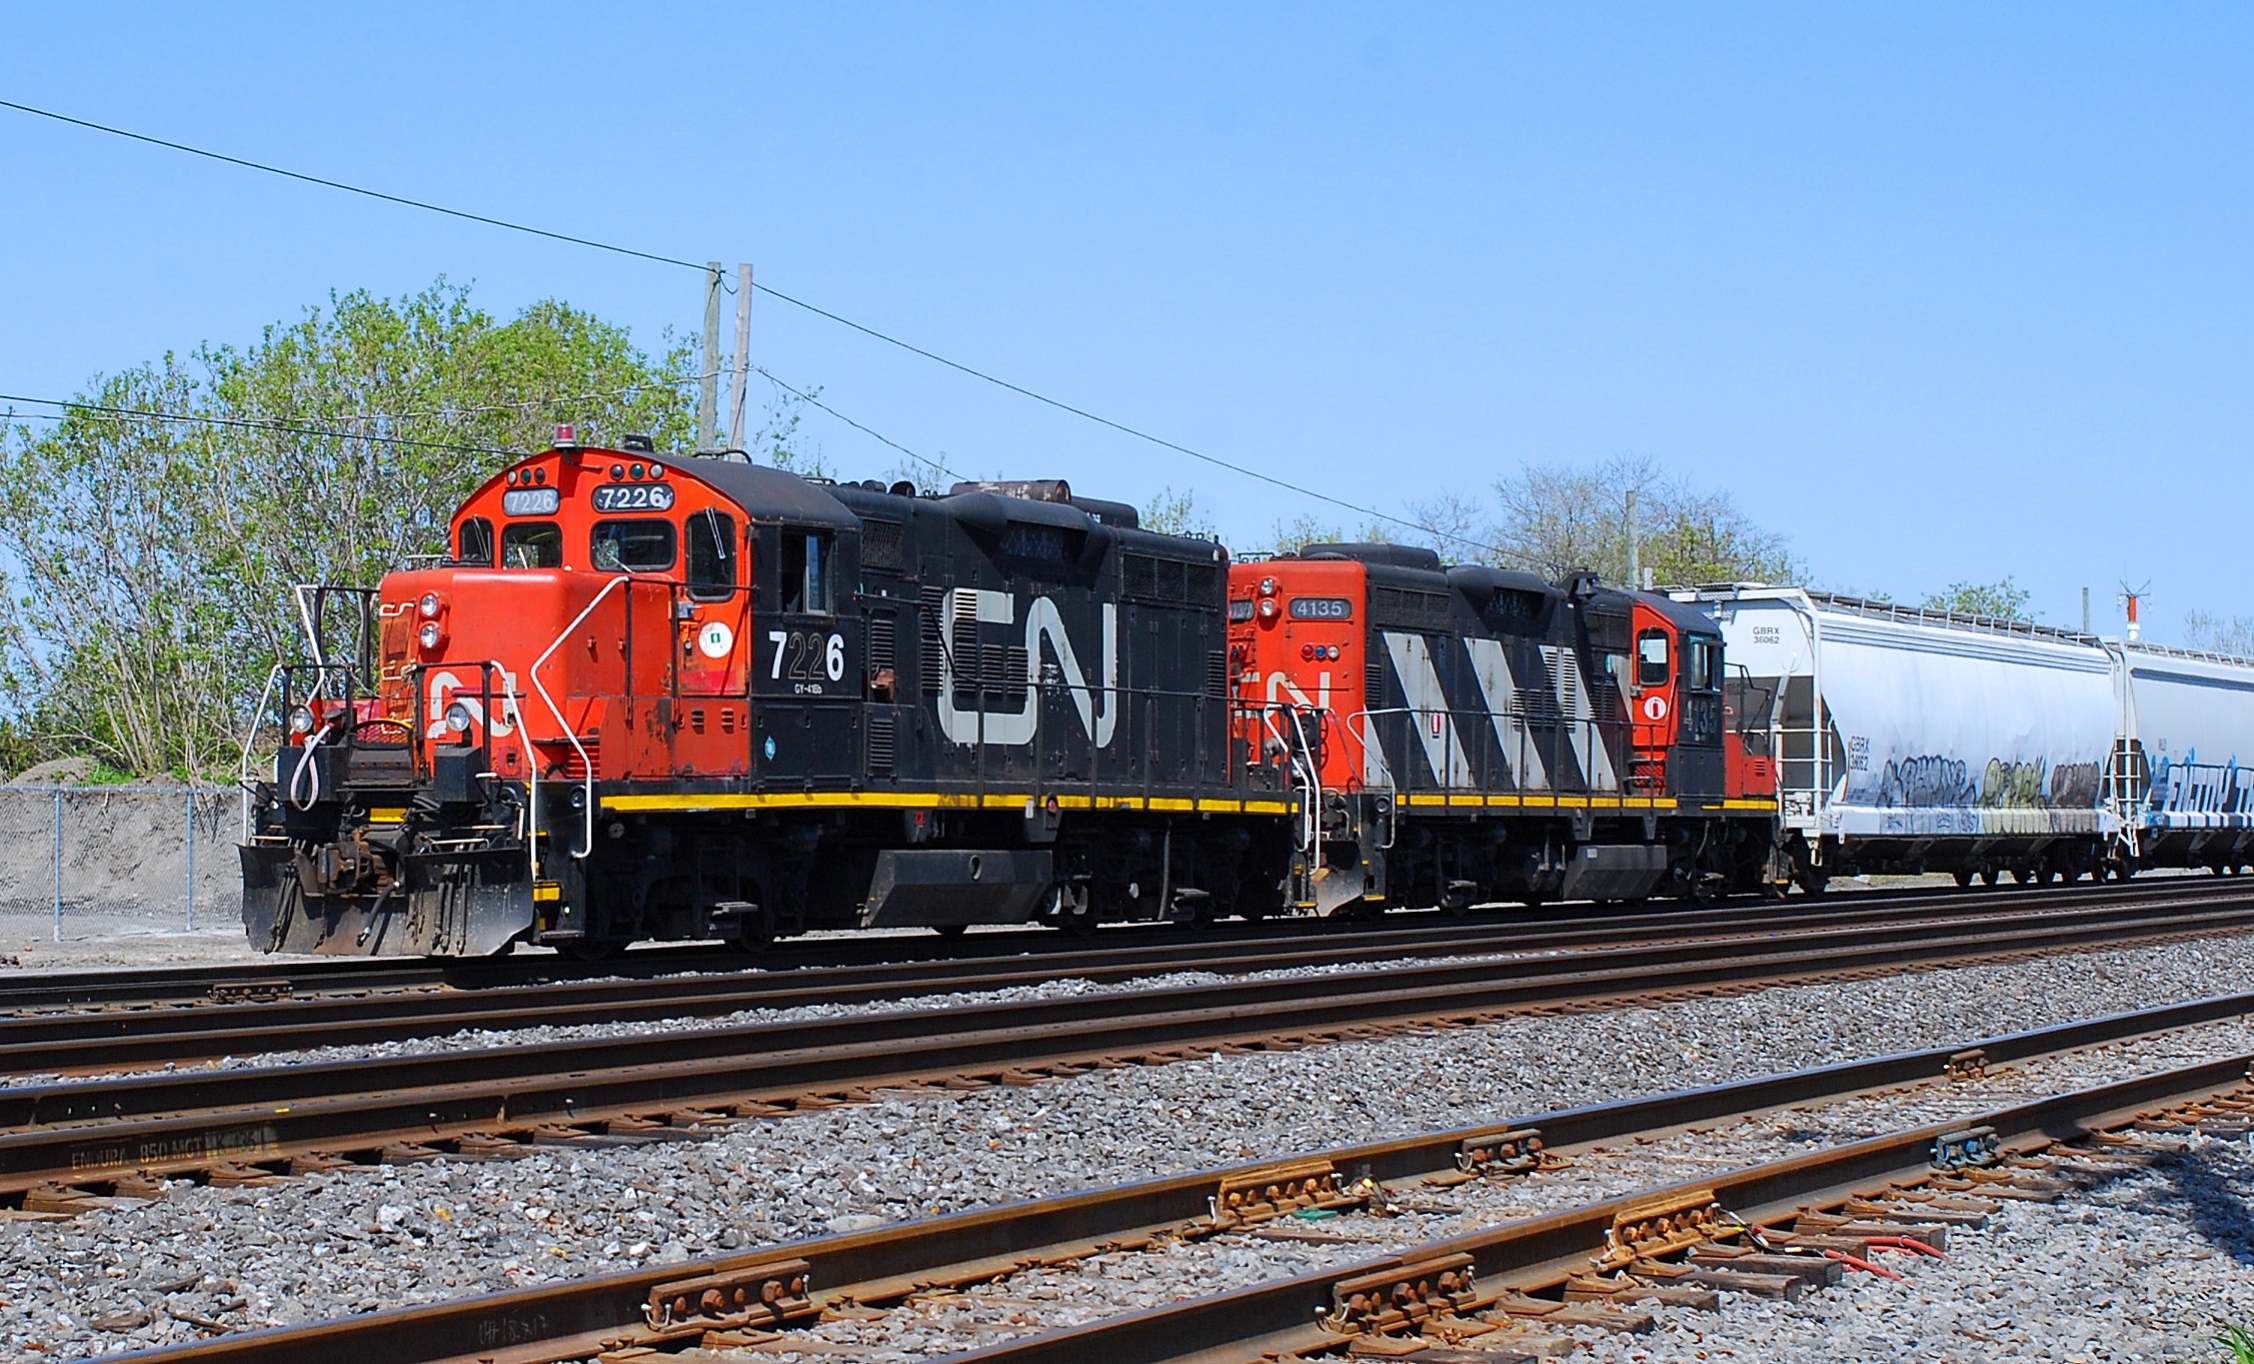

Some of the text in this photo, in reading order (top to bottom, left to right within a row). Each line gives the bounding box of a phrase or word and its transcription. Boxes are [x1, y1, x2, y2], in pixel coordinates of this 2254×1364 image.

[509, 491, 553, 513] 7226
[601, 486, 665, 510] 7226
[1296, 600, 1343, 617] 4135
[1752, 626, 1780, 635] GBRX
[1753, 635, 1780, 645] 36062
[768, 630, 845, 682] 7226
[939, 587, 1117, 748] CN
[1850, 735, 1870, 754] GBRX
[140, 1141, 168, 1164] 850
